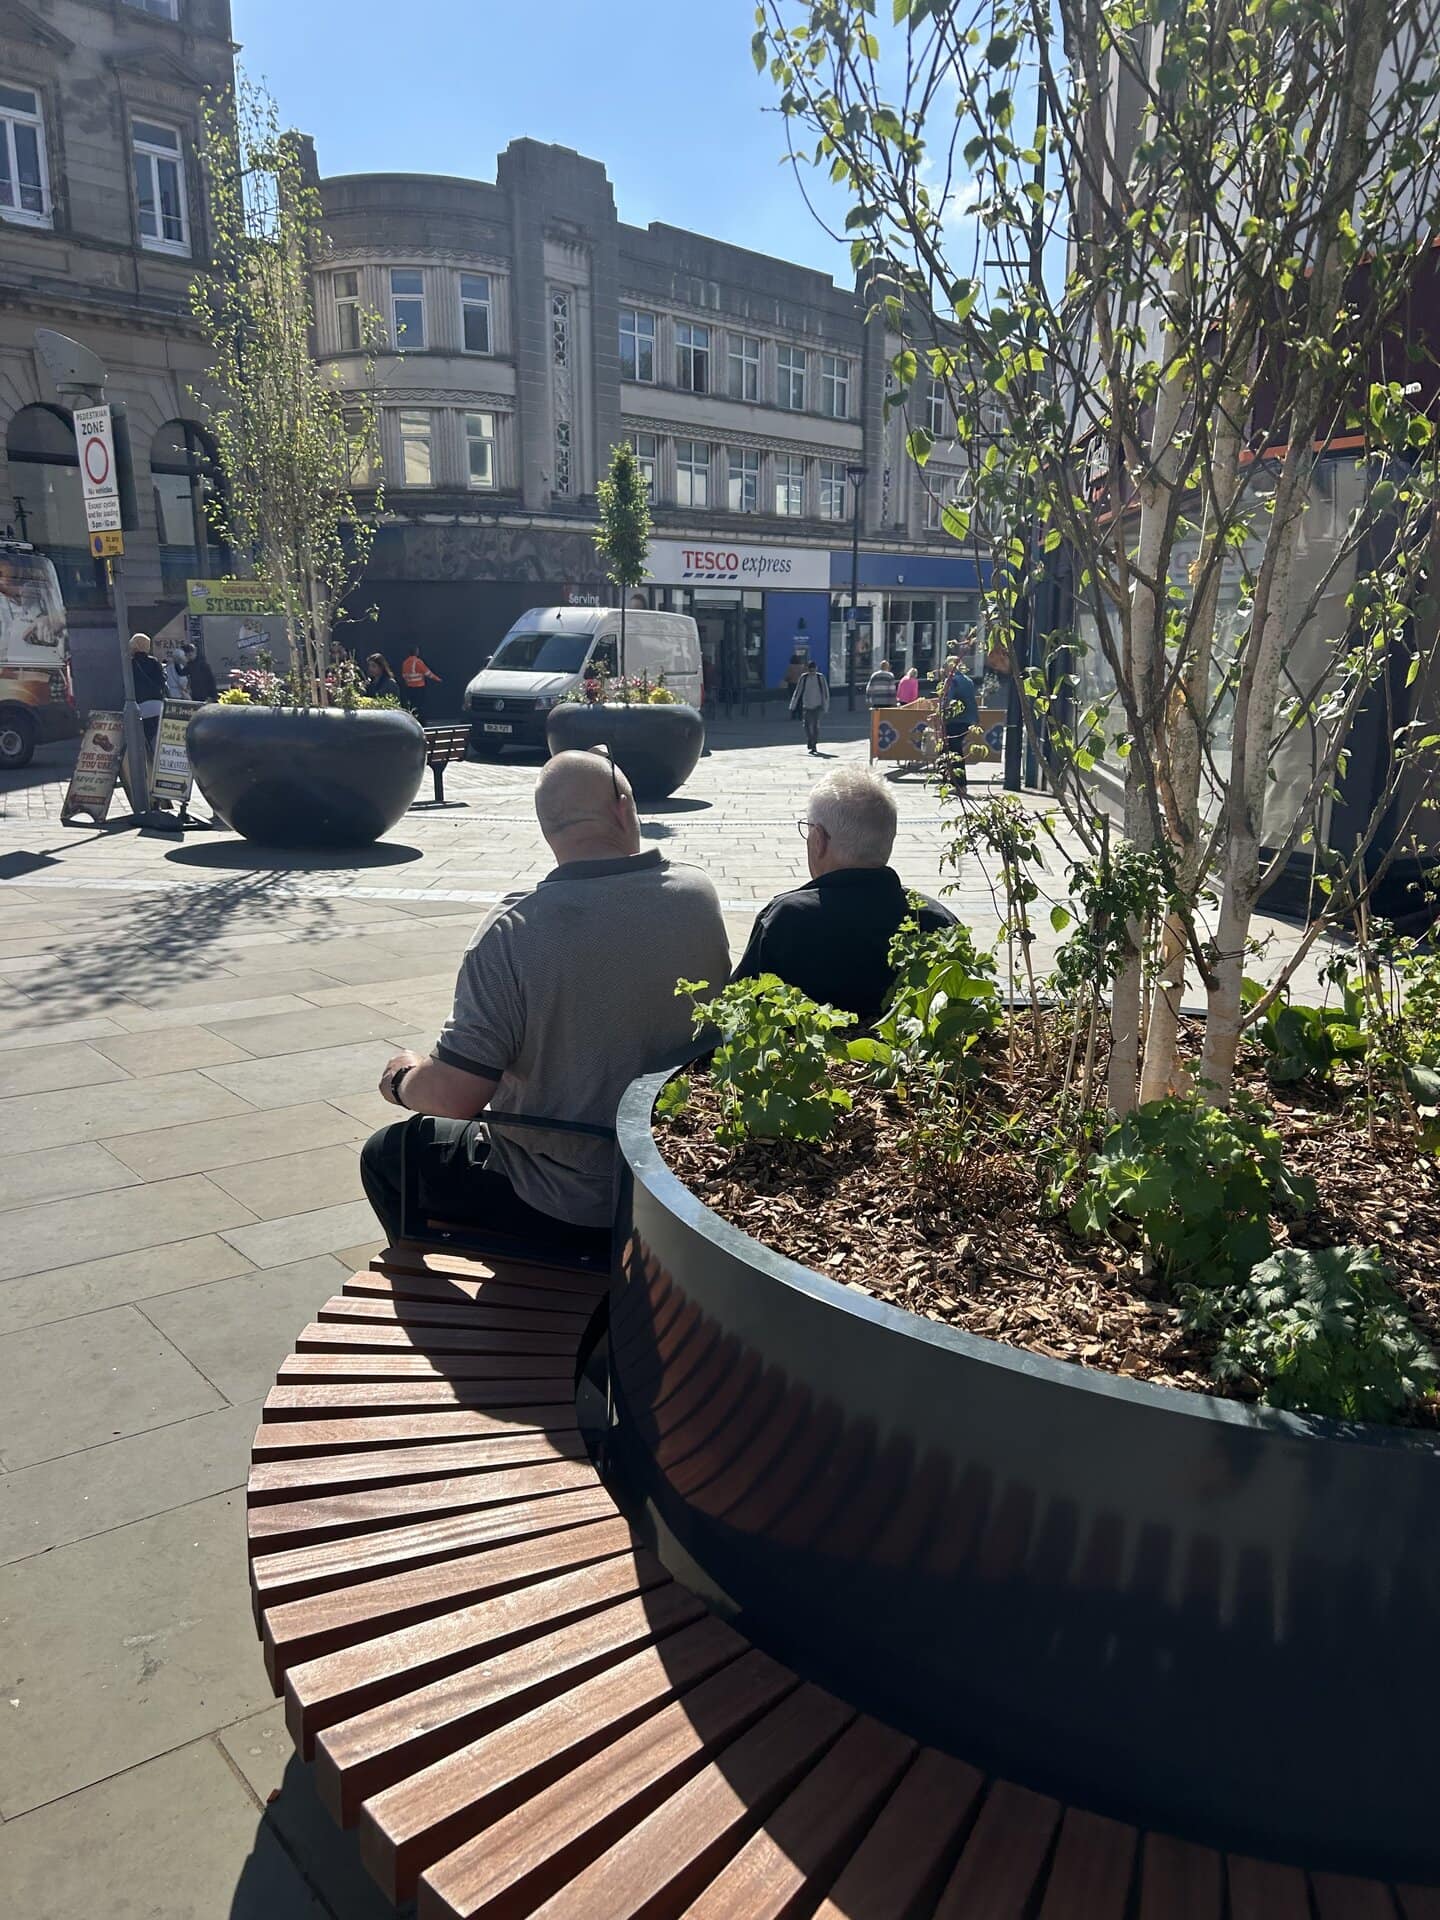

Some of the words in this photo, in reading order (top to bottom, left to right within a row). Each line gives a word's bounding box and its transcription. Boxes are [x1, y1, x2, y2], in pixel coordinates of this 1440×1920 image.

[76, 409, 107, 421] PEDESTRIAN
[81, 420, 105, 436] ZONE
[682, 550, 739, 571] TESCO
[742, 555, 792, 577] express
[206, 597, 254, 612] STREET
[568, 592, 600, 607] Serving
